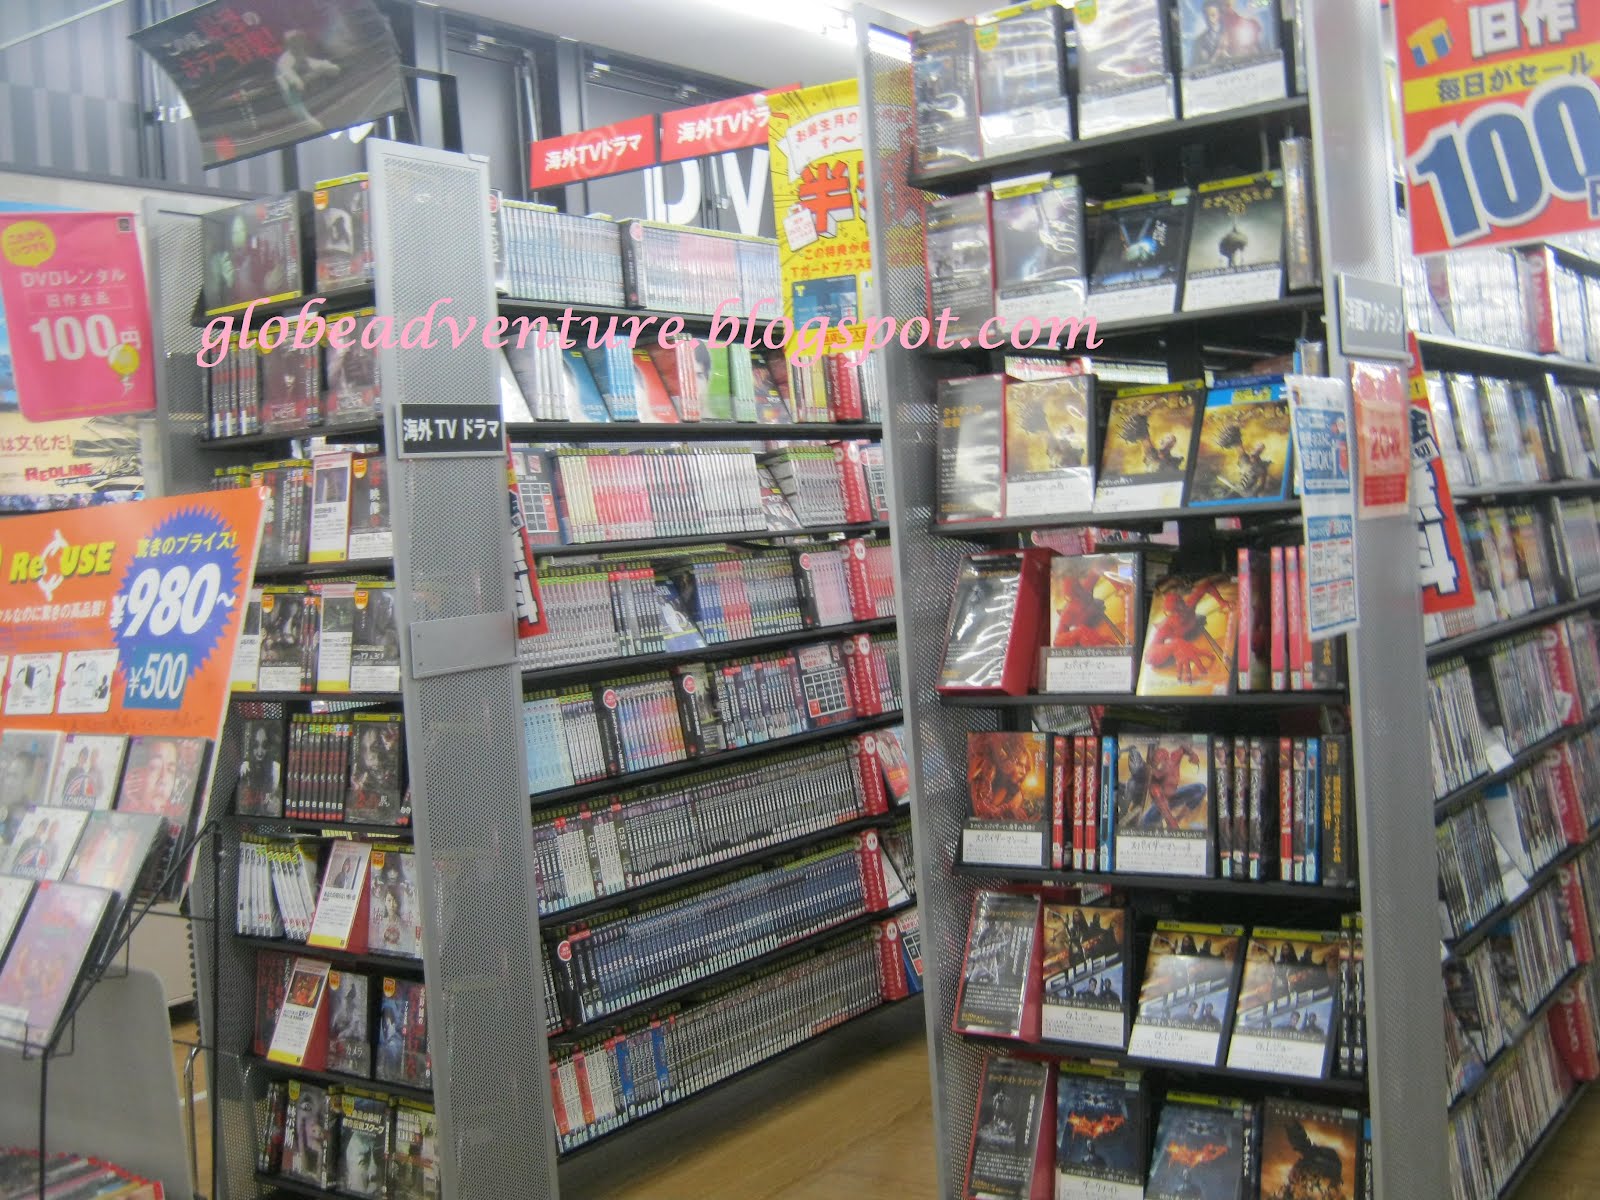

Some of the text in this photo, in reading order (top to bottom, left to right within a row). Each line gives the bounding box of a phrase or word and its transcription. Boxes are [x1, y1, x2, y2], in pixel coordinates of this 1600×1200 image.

[1437, 51, 1593, 103] 毎日がセール
[545, 134, 643, 171] 海外TVドラマ
[1406, 73, 1600, 247] 100
[21, 271, 126, 289] DVDレンタル
[129, 652, 188, 700] ¥500
